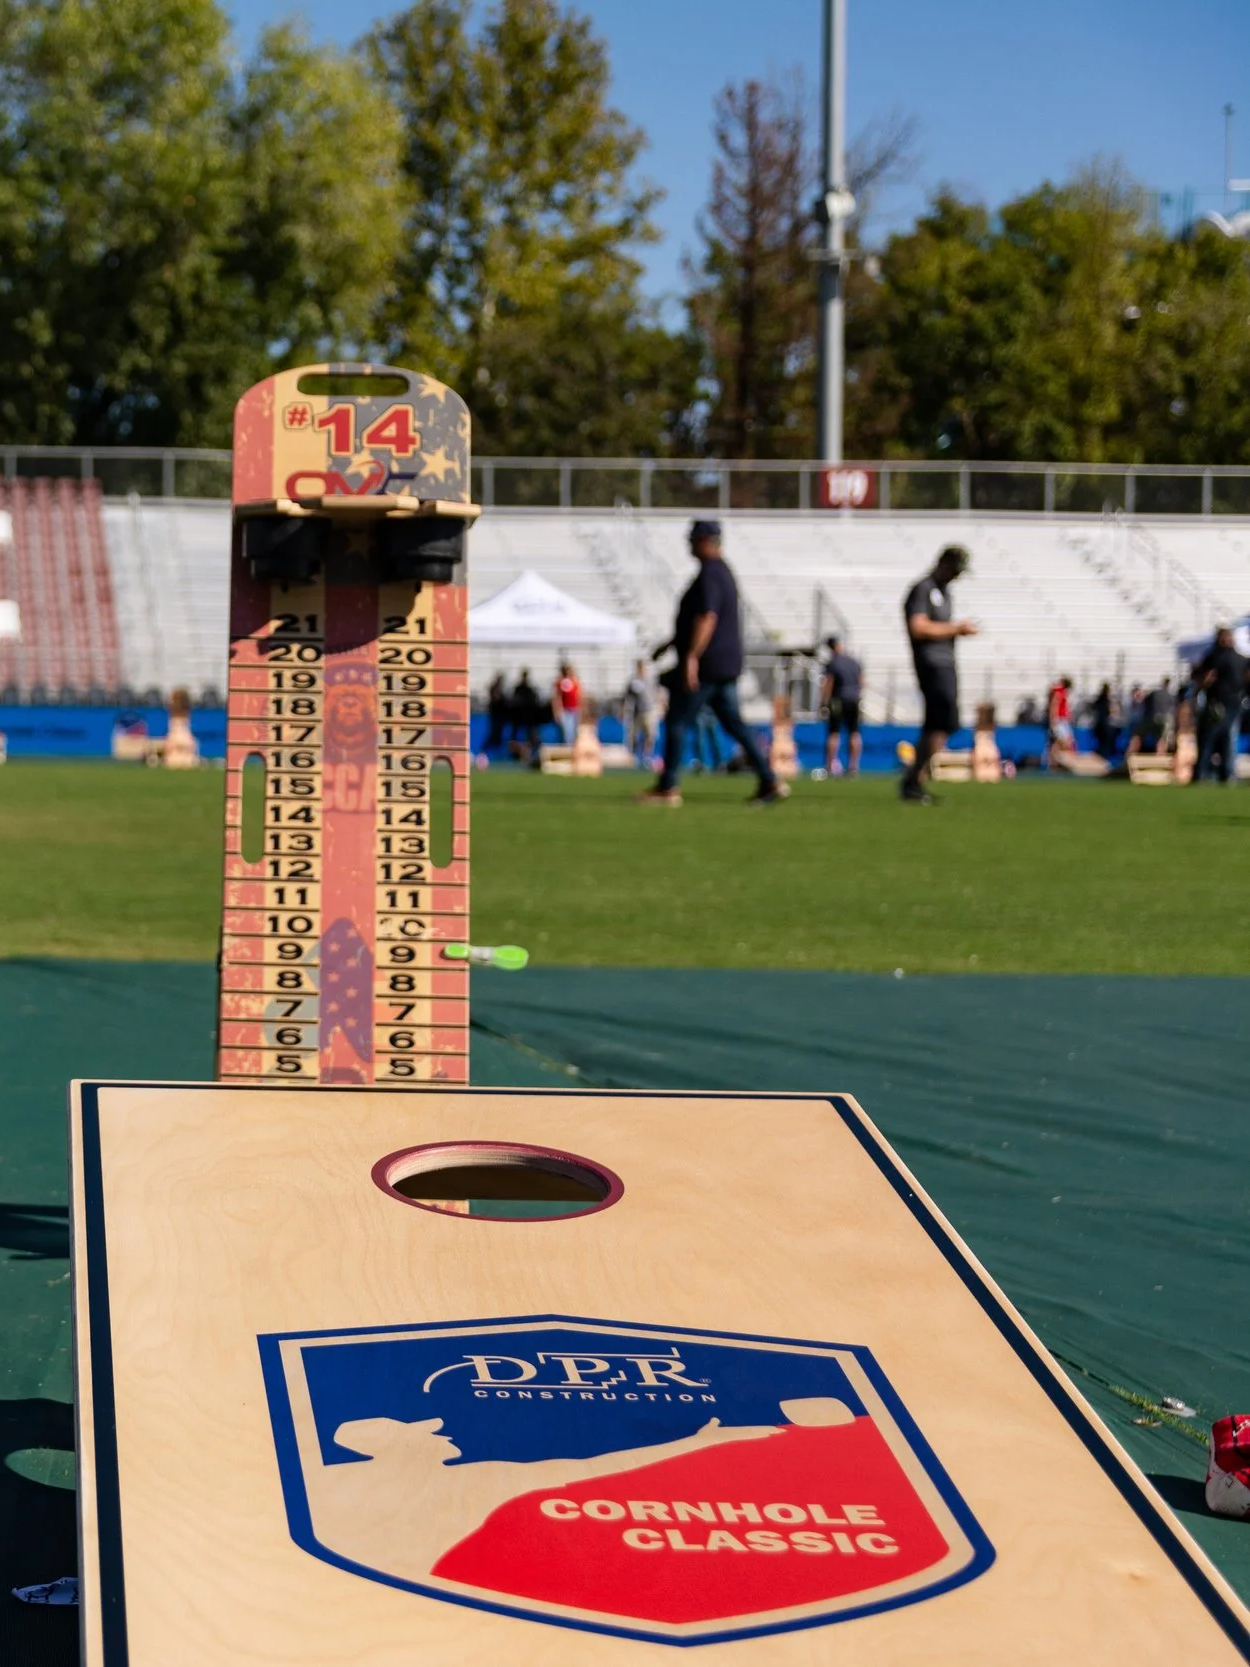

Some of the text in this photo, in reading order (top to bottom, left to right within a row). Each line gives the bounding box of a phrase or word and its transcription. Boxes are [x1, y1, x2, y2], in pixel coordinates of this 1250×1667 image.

[286, 403, 419, 456] #14
[275, 614, 318, 633] 21
[383, 616, 426, 635] 21
[269, 645, 323, 662] 20
[379, 648, 431, 665] 20
[272, 671, 316, 690] 19
[382, 674, 426, 692] 19
[272, 697, 316, 716] 18
[382, 701, 426, 718] 18
[272, 725, 316, 742] 17
[382, 729, 426, 745] 17
[271, 751, 315, 769] 16
[382, 754, 426, 772] 16
[271, 778, 314, 795] 15
[382, 780, 426, 798] 15
[270, 804, 314, 823] 14
[381, 808, 426, 826] 14
[269, 833, 314, 852] 13
[381, 836, 426, 855] 13
[268, 861, 314, 880] 12
[380, 863, 426, 882] 12
[274, 887, 308, 905] 11
[385, 890, 420, 908] 11
[268, 916, 313, 933] 10
[277, 942, 303, 960] 9
[389, 946, 415, 964] 9
[277, 970, 302, 989] 8
[389, 974, 415, 992] 8
[276, 999, 303, 1017] 7
[389, 1003, 415, 1021] 7
[275, 1027, 302, 1045] 6
[389, 1031, 415, 1050] 6
[275, 1055, 302, 1074] 5
[389, 1059, 415, 1077] 5
[462, 1353, 710, 1387] DPR
[474, 1390, 717, 1403] CONSTRUCTION
[540, 1498, 886, 1526] CORNHOLE
[622, 1528, 900, 1555] CLASSIC
